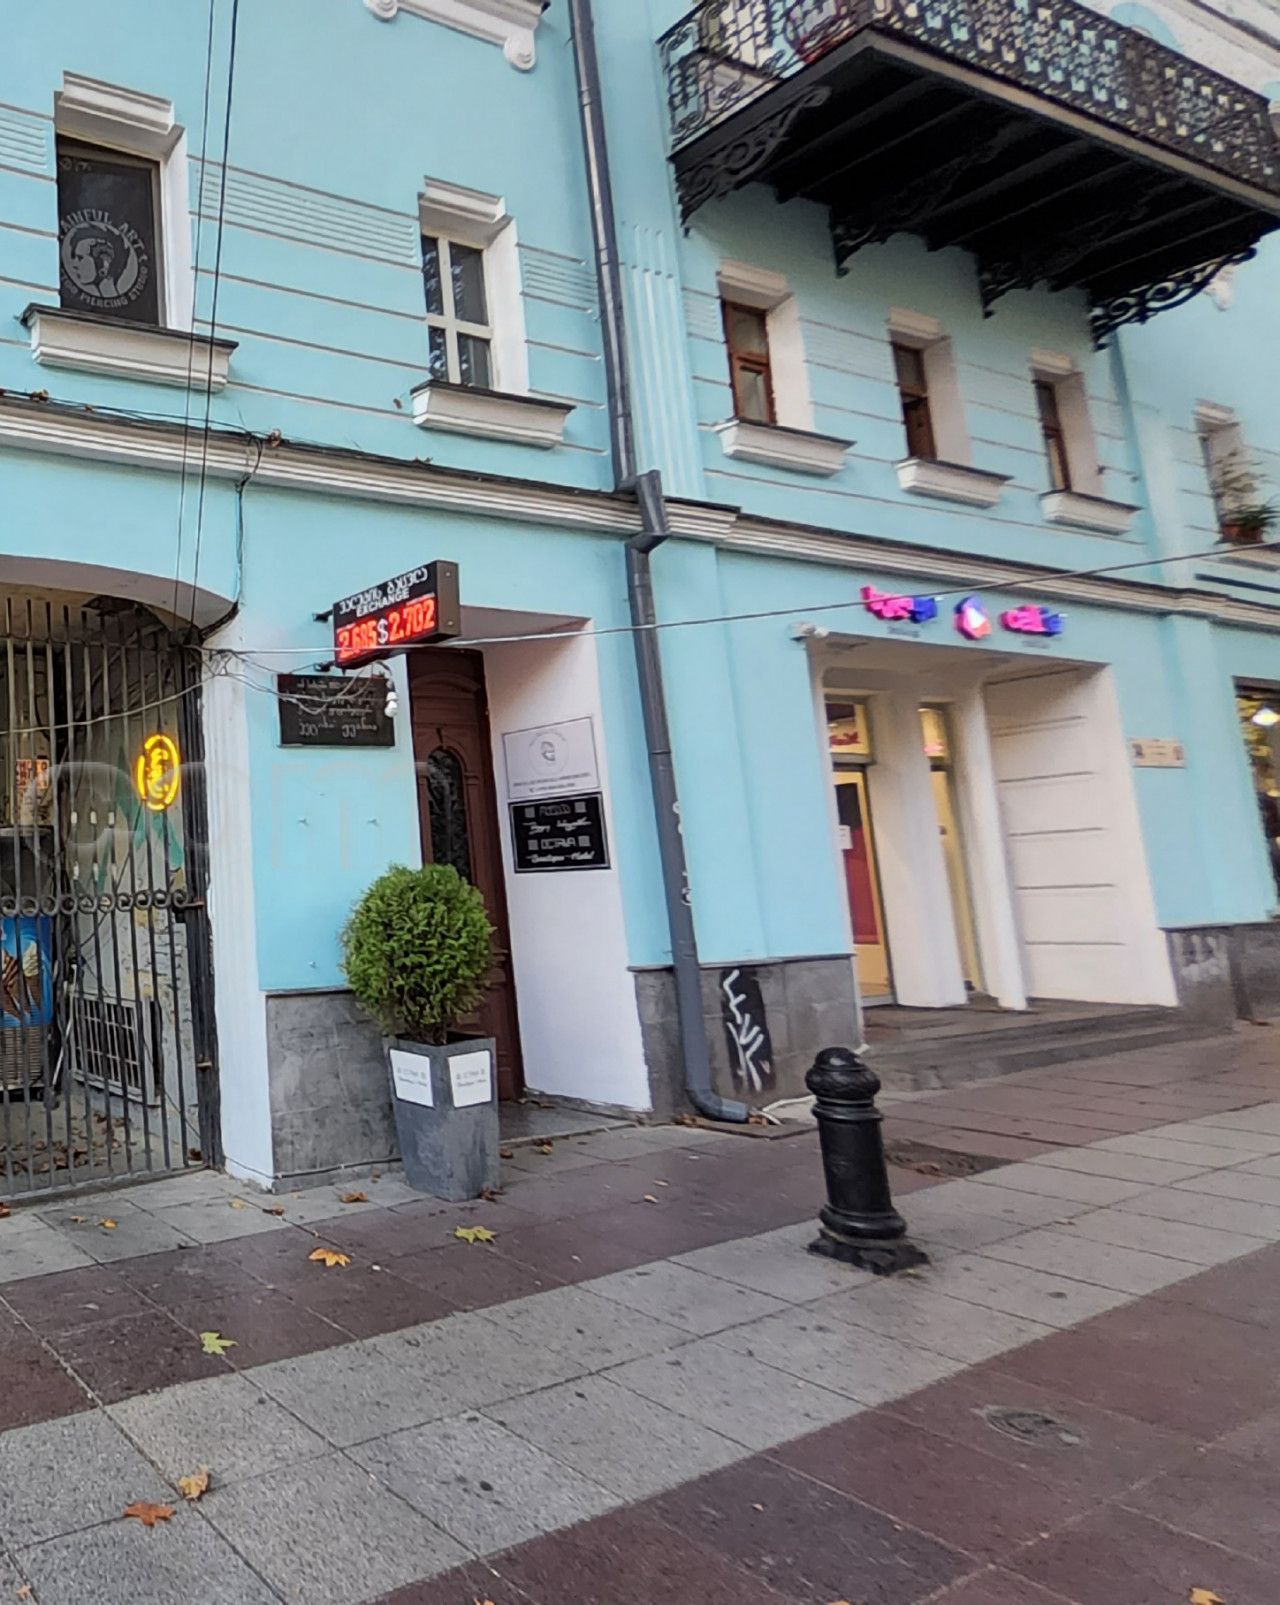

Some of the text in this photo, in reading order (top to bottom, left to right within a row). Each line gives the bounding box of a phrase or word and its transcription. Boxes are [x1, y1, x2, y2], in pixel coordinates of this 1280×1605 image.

[61, 208, 146, 252] AINFUL ART
[356, 587, 410, 618] EXCHANGE
[388, 598, 436, 642] 2.702
